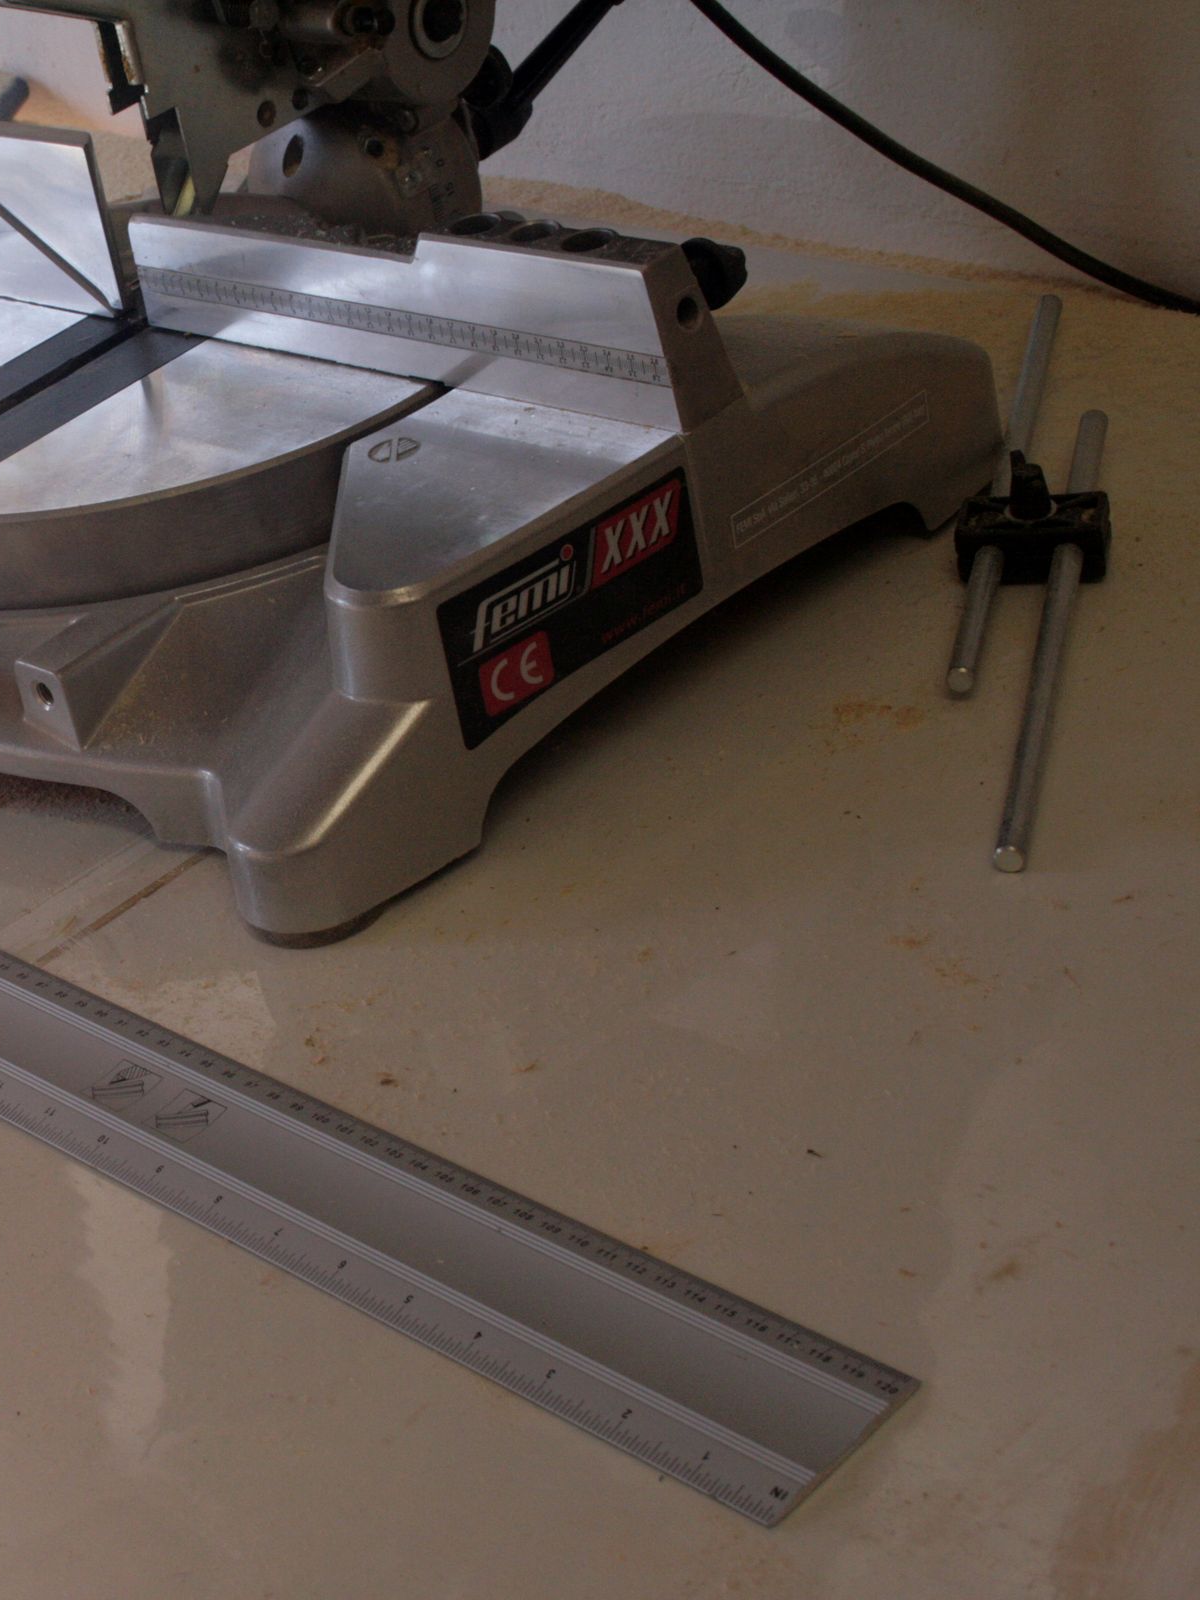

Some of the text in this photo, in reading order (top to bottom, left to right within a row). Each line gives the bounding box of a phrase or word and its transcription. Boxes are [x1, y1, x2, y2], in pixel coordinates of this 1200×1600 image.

[600, 491, 673, 574] XXX
[470, 544, 575, 653] femi
[490, 640, 544, 702] CE
[545, 1369, 556, 1379] 3
[621, 1408, 633, 1420] 2
[702, 1451, 710, 1461] 1
[770, 1486, 788, 1500] IN
